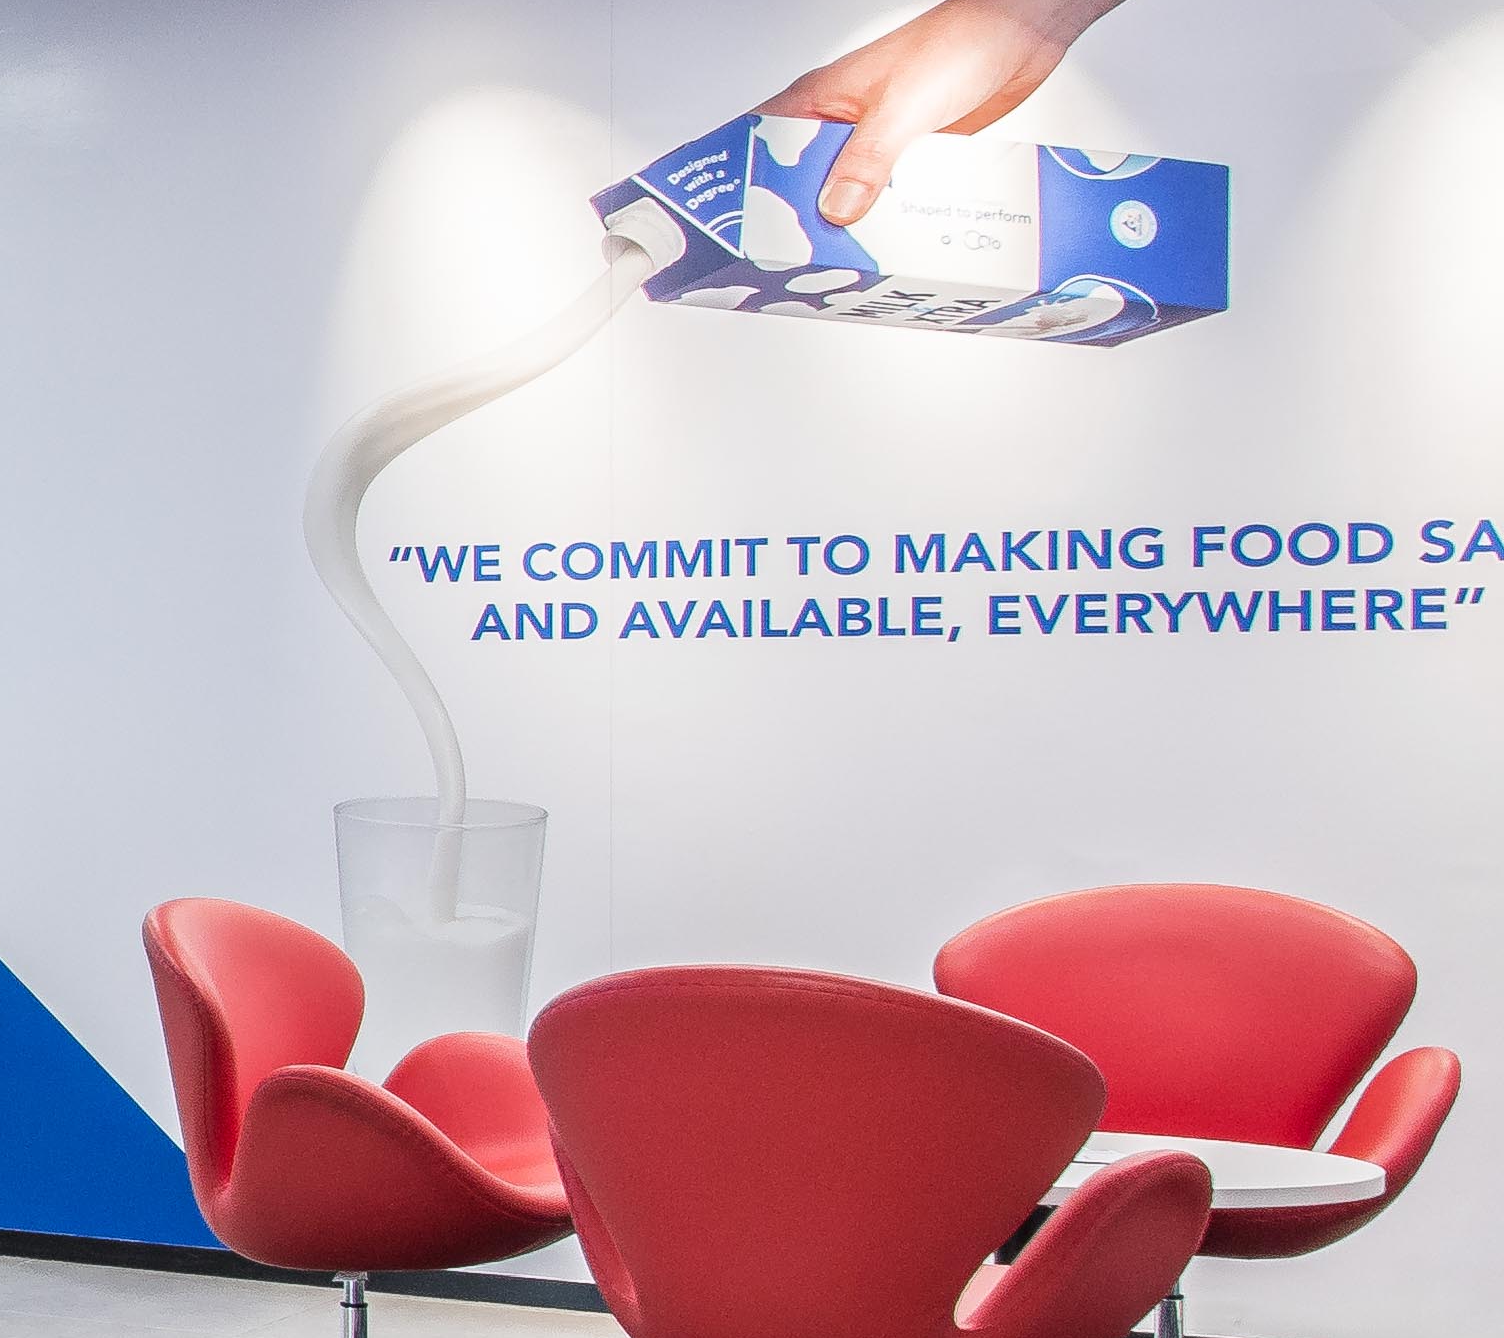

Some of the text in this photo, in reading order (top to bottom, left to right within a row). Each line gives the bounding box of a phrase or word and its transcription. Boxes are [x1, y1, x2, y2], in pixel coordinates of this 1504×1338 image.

[667, 150, 728, 185] Designed
[684, 170, 725, 192] with a
[975, 209, 1032, 224] perform
[836, 290, 936, 318] MILK
[522, 538, 769, 582] COMMIT
[786, 534, 871, 577] TO
[894, 528, 1164, 574] MAKING
[1193, 522, 1394, 568] FOOD
[471, 601, 599, 641] AND
[618, 596, 961, 642] AVAILABLE,
